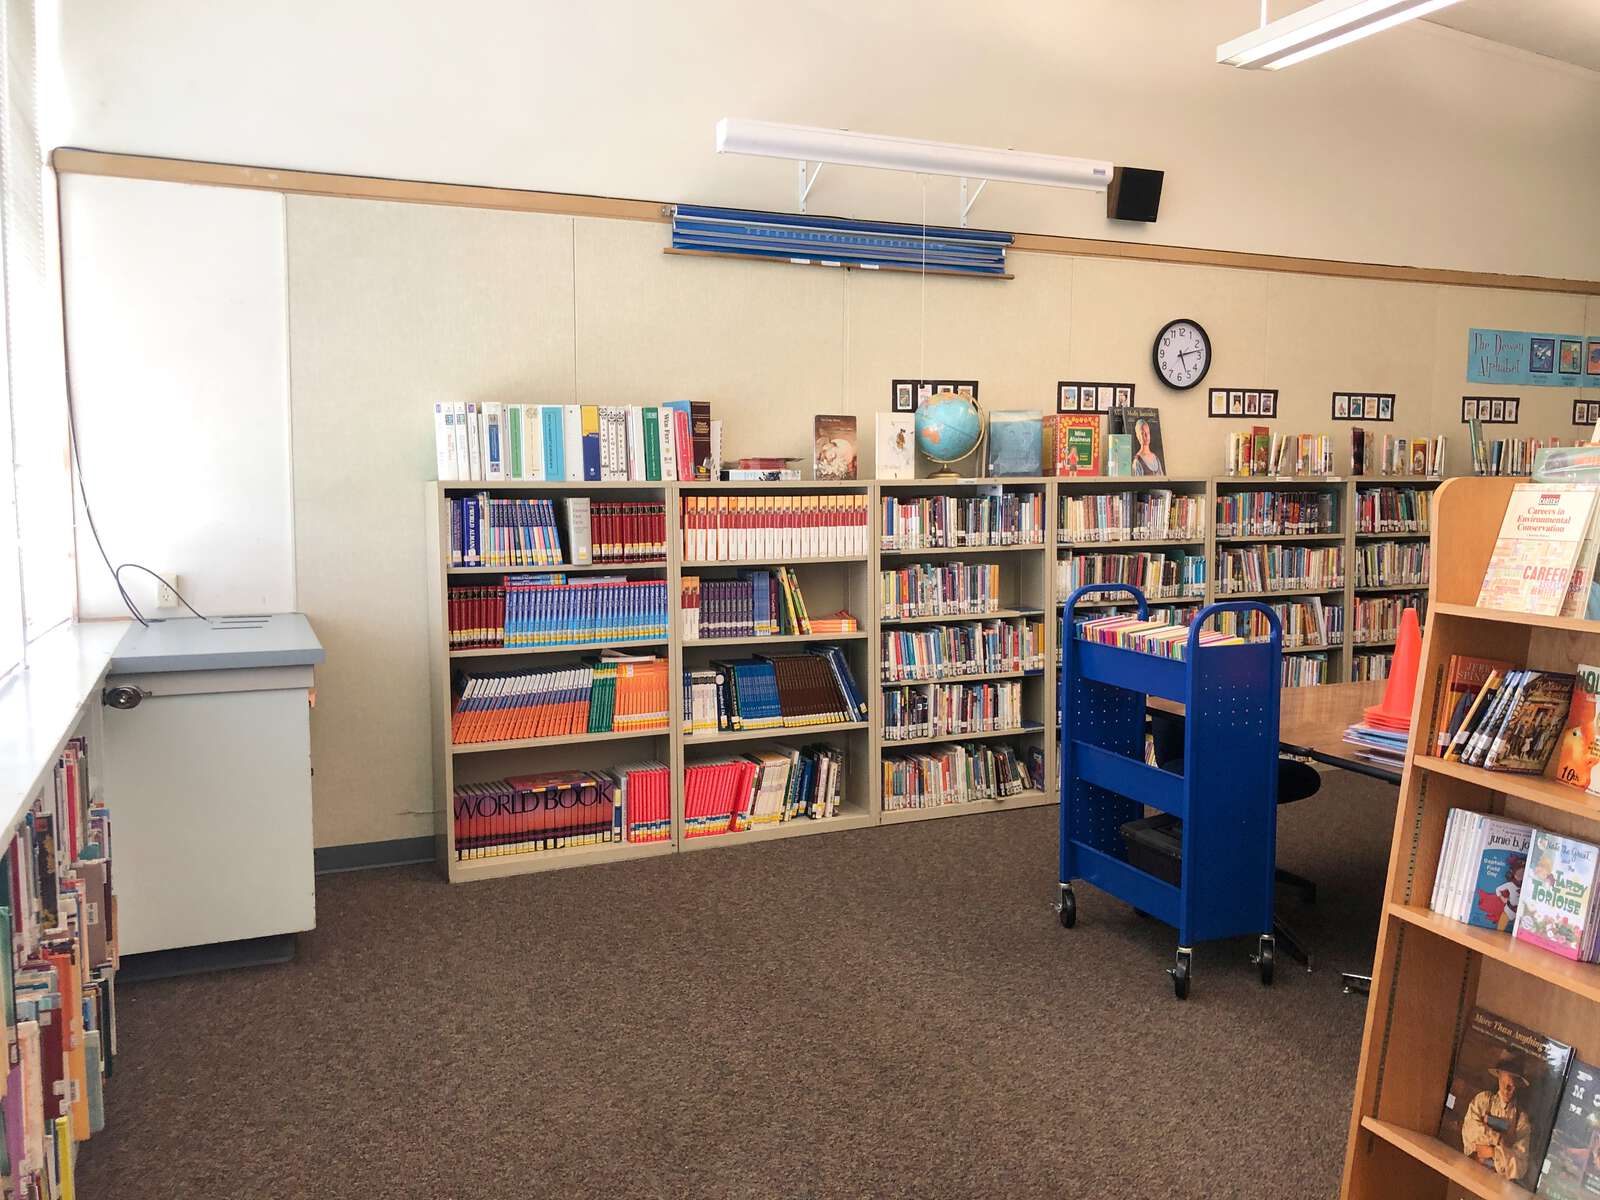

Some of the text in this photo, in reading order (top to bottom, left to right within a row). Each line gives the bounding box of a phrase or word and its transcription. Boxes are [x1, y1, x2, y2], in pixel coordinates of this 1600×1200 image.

[1170, 330, 1176, 339] 11
[1178, 328, 1186, 336] 12
[1189, 330, 1192, 339] 1
[1164, 338, 1171, 347] 10
[1194, 340, 1200, 348] 2
[1473, 332, 1489, 354] The
[1160, 350, 1165, 359] 9
[1197, 351, 1202, 360] 3
[1162, 362, 1167, 370] 8
[1192, 364, 1198, 372] 4
[1169, 369, 1174, 378] 7
[1177, 372, 1182, 382] 6
[1186, 370, 1191, 379] 5
[1528, 507, 1556, 515] Careers
[1517, 515, 1571, 524] Environmental
[1517, 524, 1565, 532] Conservation
[1523, 566, 1569, 583] CAREER
[455, 783, 614, 820] WORLD BOOK
[1488, 835, 1511, 847] junie
[1532, 878, 1582, 915] TORTOISE
[1474, 1013, 1545, 1052] More Than Anything
